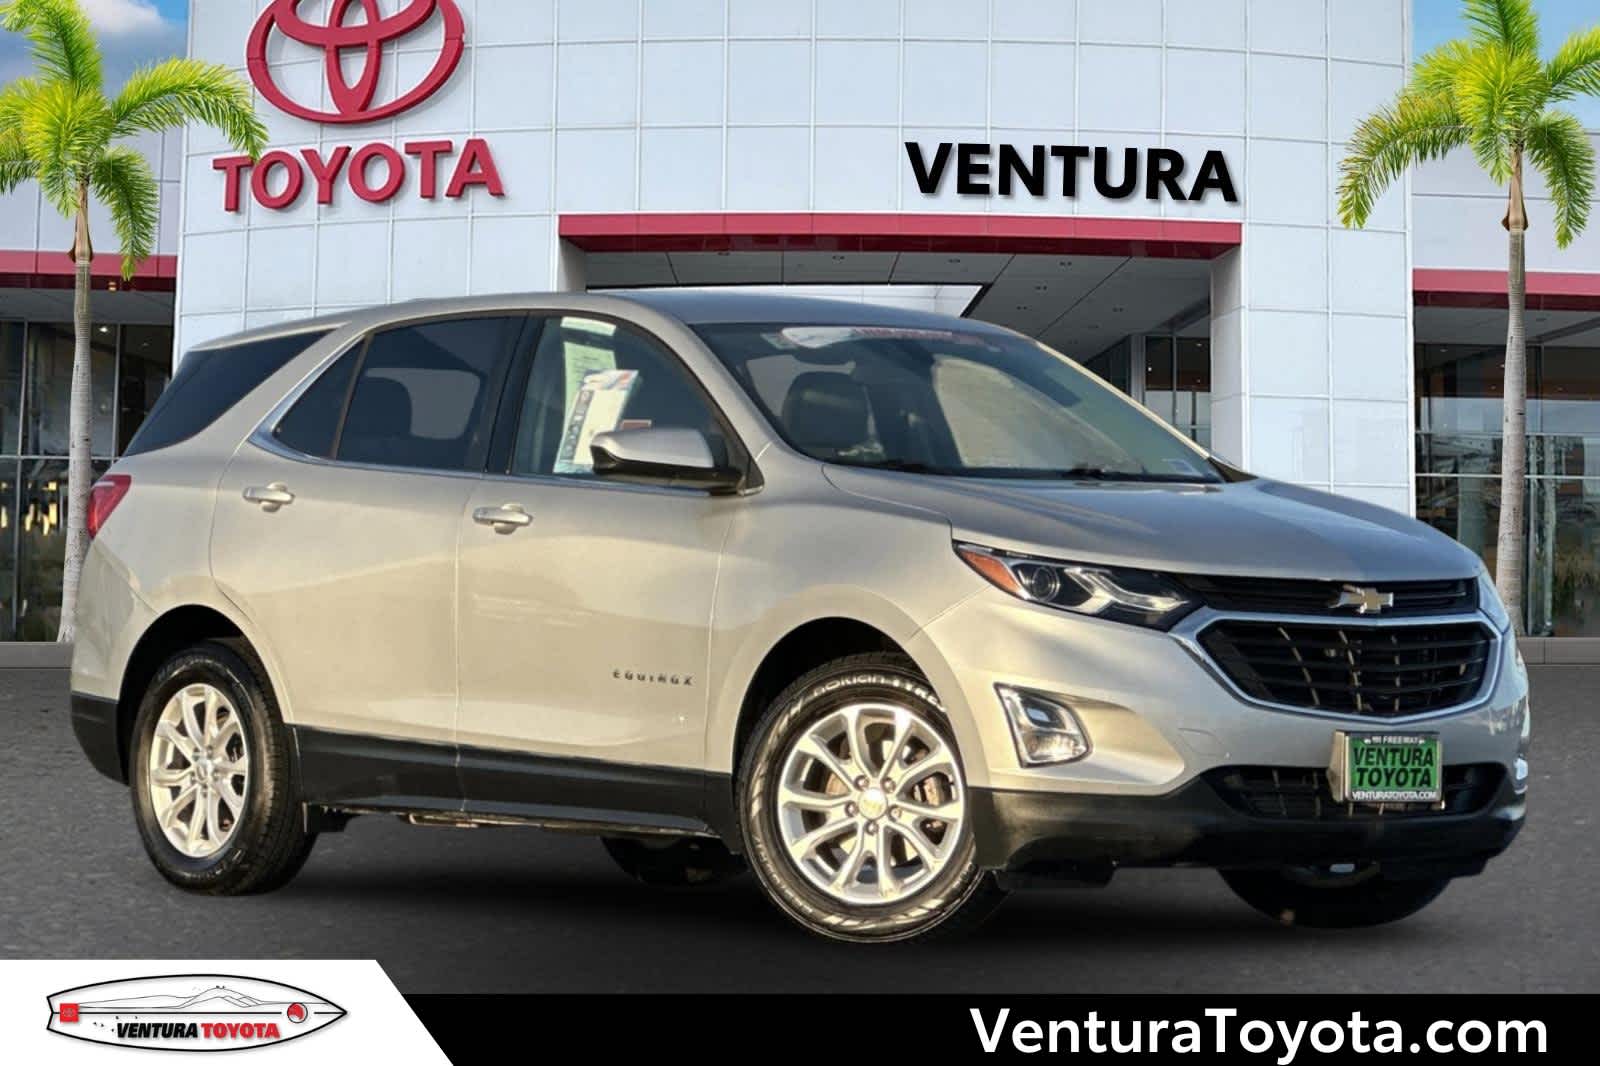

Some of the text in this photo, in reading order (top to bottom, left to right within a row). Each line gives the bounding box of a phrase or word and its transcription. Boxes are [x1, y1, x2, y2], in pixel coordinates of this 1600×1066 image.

[213, 138, 505, 212] TOYOTA
[904, 142, 1240, 203] VENTURA
[1353, 747, 1434, 767] VENTURA
[1356, 767, 1432, 788] TOYOTA
[1352, 790, 1437, 801] VENTURATOYOTA.COM
